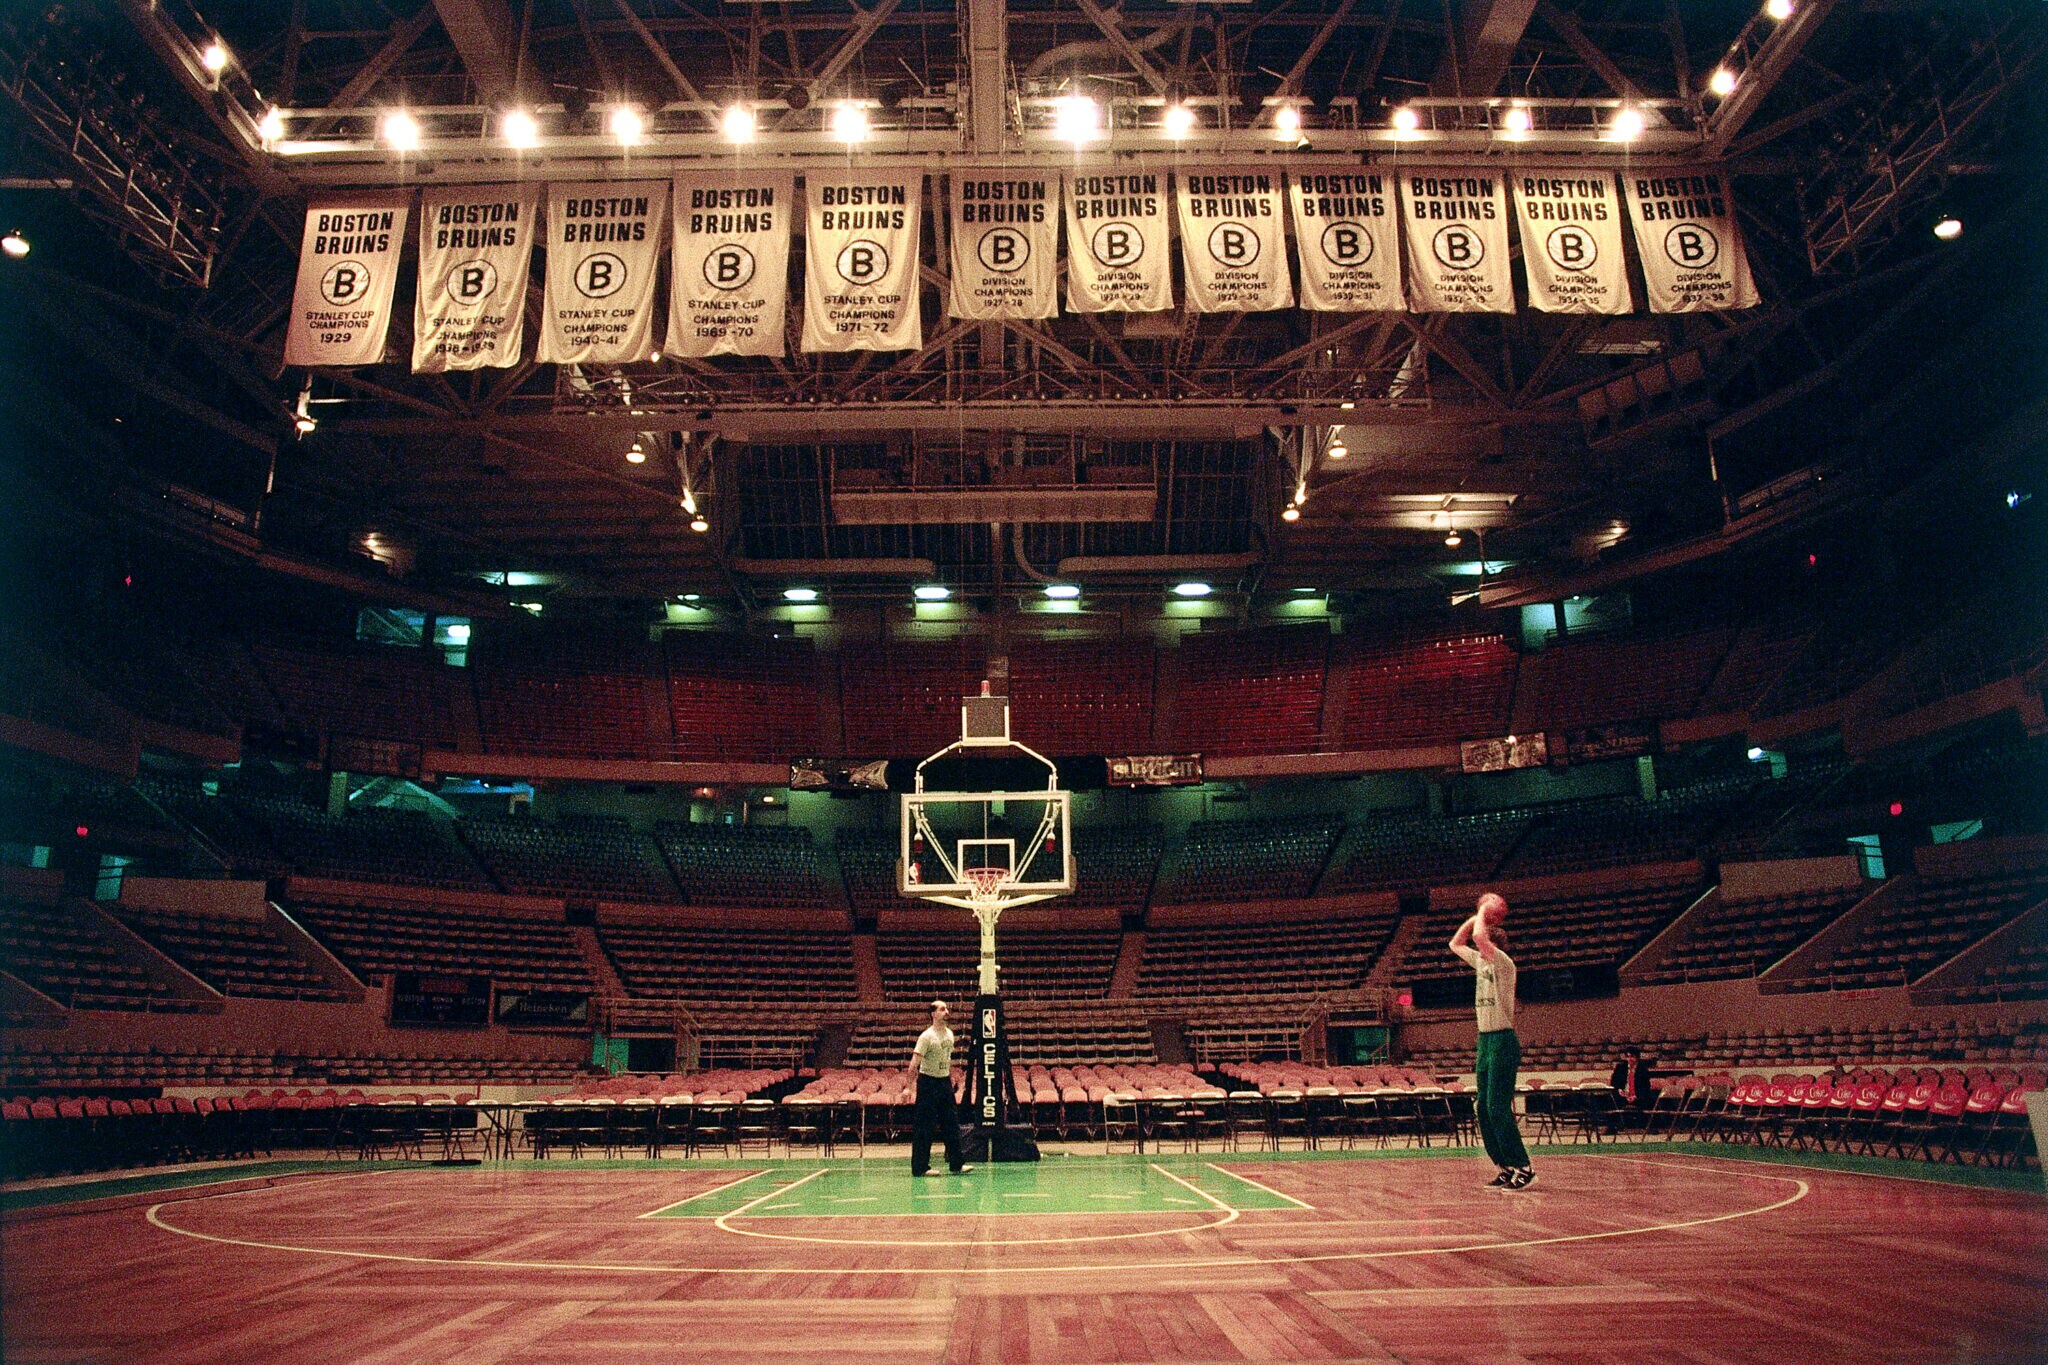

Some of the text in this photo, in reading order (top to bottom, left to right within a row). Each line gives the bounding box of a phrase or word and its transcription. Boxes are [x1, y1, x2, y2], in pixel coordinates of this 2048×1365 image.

[962, 180, 1046, 200] BOSTON
[1074, 175, 1156, 196] BOSTON
[1188, 174, 1270, 195] BOSTON
[1301, 174, 1382, 195] BOSTON
[1411, 176, 1494, 198] BOSTON
[1523, 177, 1605, 199] BOSTON
[1636, 175, 1722, 199] BOSTON
[691, 187, 774, 209] BOSTON
[822, 185, 905, 206] BOSTON
[439, 202, 519, 225] BOSTON
[566, 197, 648, 218] BOSTON
[962, 203, 1045, 222] BRUINS
[1076, 198, 1157, 219] BRUINS
[1191, 198, 1271, 218] BRUINS
[1303, 198, 1385, 217] BRUINS
[1415, 200, 1496, 220] BRUINS
[1527, 202, 1608, 221] BRUINS
[1641, 198, 1726, 221] BRUINS
[318, 211, 394, 233] BOSTON
[691, 212, 772, 234] BRUINS
[822, 210, 904, 230] BRUINS
[437, 226, 516, 249] BRUINS
[564, 221, 646, 242] BRUINS
[314, 233, 389, 255] BRUINS
[993, 235, 1015, 264] B
[1108, 230, 1130, 259] B
[1223, 230, 1245, 259] B
[1336, 229, 1358, 259] B
[1447, 233, 1471, 261] B
[1561, 233, 1584, 262] B
[1678, 231, 1705, 261] B
[718, 252, 740, 282] B
[851, 248, 874, 276] B
[333, 269, 355, 298] B
[461, 268, 484, 298] B
[589, 261, 612, 290] B
[982, 277, 1026, 286] DIVISION
[1098, 271, 1141, 281] DIVISION
[1215, 271, 1259, 280] DIVISION
[1322, 281, 1381, 290] CHAMPIONS
[1329, 271, 1373, 280] DIVISION
[1440, 274, 1484, 283] DIVISION
[1555, 275, 1598, 284] DIVISION
[1676, 272, 1721, 282] DIVISION
[974, 288, 1033, 296] CHAMPIONS
[1090, 282, 1150, 291] CHAMPIONS
[1208, 282, 1267, 291] CHAMPIONS
[1548, 284, 1608, 294] CHAMPIONS
[1671, 280, 1732, 293] CHAMPIONS
[688, 299, 766, 310] STANLEY CUP
[824, 294, 901, 306] STANLEY CUP
[306, 310, 375, 321] STANLEY CUP
[433, 315, 505, 327] STANLEY CUP
[559, 309, 635, 319] STANLEY CUP
[693, 314, 759, 325] CHAMPIONS
[829, 310, 895, 320] CHAMPIONS
[310, 320, 369, 330] CHAMPIONS
[563, 324, 628, 334] CHAMPIONS
[320, 332, 352, 344] 1929
[983, 1043, 997, 1118] CELTICS
